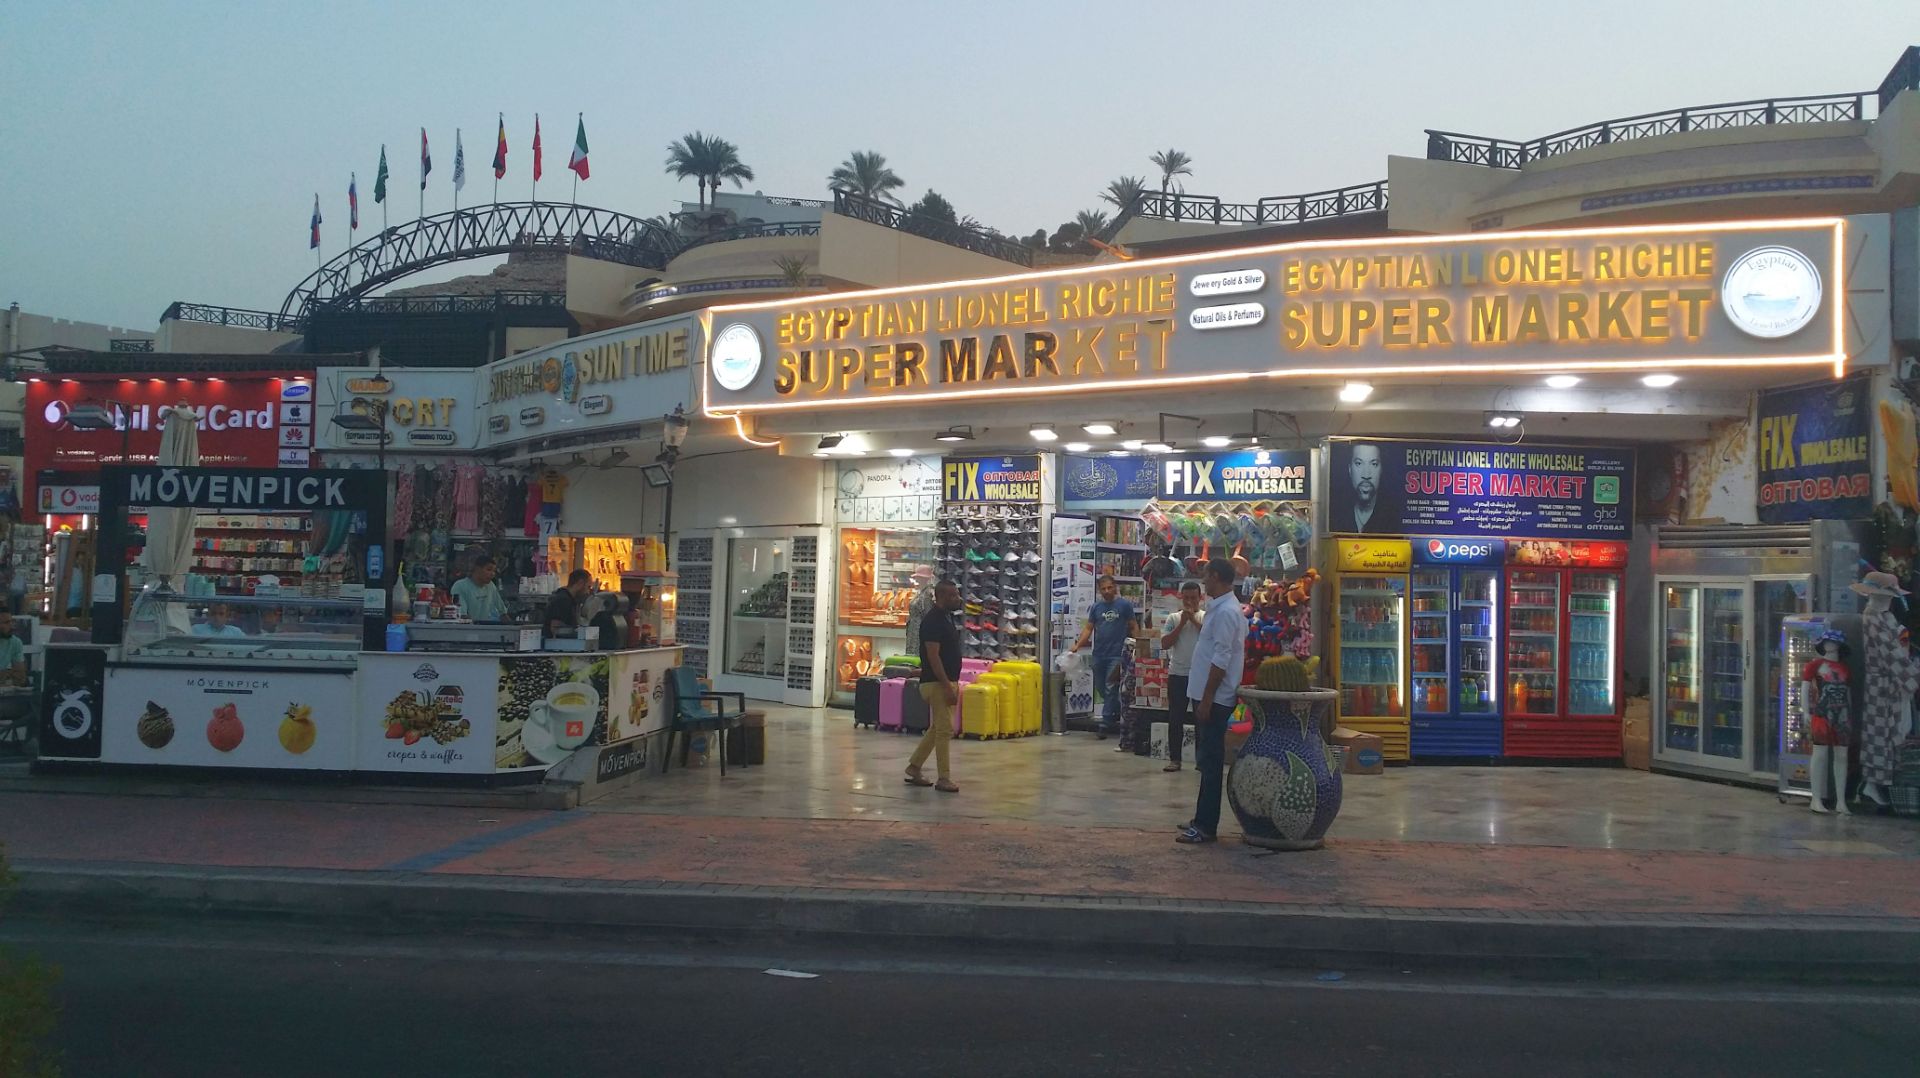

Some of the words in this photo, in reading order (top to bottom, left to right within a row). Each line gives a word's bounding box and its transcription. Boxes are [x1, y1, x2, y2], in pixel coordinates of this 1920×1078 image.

[1283, 253, 1453, 293] EGYPTIAN
[1461, 247, 1583, 285] LIONEL
[1593, 241, 1713, 280] RICHIE
[1746, 255, 1799, 272] Egyptian
[1222, 277, 1236, 286] Gold
[1237, 276, 1243, 285] &
[1244, 275, 1262, 284] Silver
[776, 299, 927, 345] EGYPTIAN
[937, 288, 1048, 331] LIONEL
[1056, 273, 1176, 319] RICHIE
[1192, 313, 1214, 324] Natural
[1215, 312, 1227, 322] Oils
[1228, 310, 1233, 320] &
[1233, 309, 1262, 320] Perfumes
[1281, 297, 1454, 350] SUPER
[1471, 288, 1713, 342] MARKET
[774, 342, 929, 395] SUPER
[938, 319, 1175, 384] MARKET
[1760, 414, 1799, 471] FIX
[1801, 435, 1867, 466] WHOLESALE
[1406, 449, 1455, 467] EGYPTIAN
[1457, 450, 1491, 468] LIONEL
[1493, 451, 1526, 470] RICHIE
[1528, 453, 1585, 471] WHOLESALE
[945, 462, 980, 500] FIX
[983, 470, 1039, 482] ОПТОВАЯ
[1165, 460, 1215, 495] FIX
[1221, 466, 1305, 480] ОПТОВАЯ
[1405, 470, 1484, 495] SUPER
[1490, 473, 1587, 499] MARKET
[130, 468, 345, 506] MÖVENPICK
[984, 482, 1039, 499] WHOLESALE
[1223, 479, 1304, 494] WHOLESALE
[1761, 473, 1870, 505] ОПТОВАЯ
[1593, 506, 1617, 523] ghd
[544, 521, 552, 534] 7
[1448, 543, 1492, 559] pepsi
[187, 678, 269, 689] MÖVENPICK
[599, 751, 646, 775] MÖVENPICK
